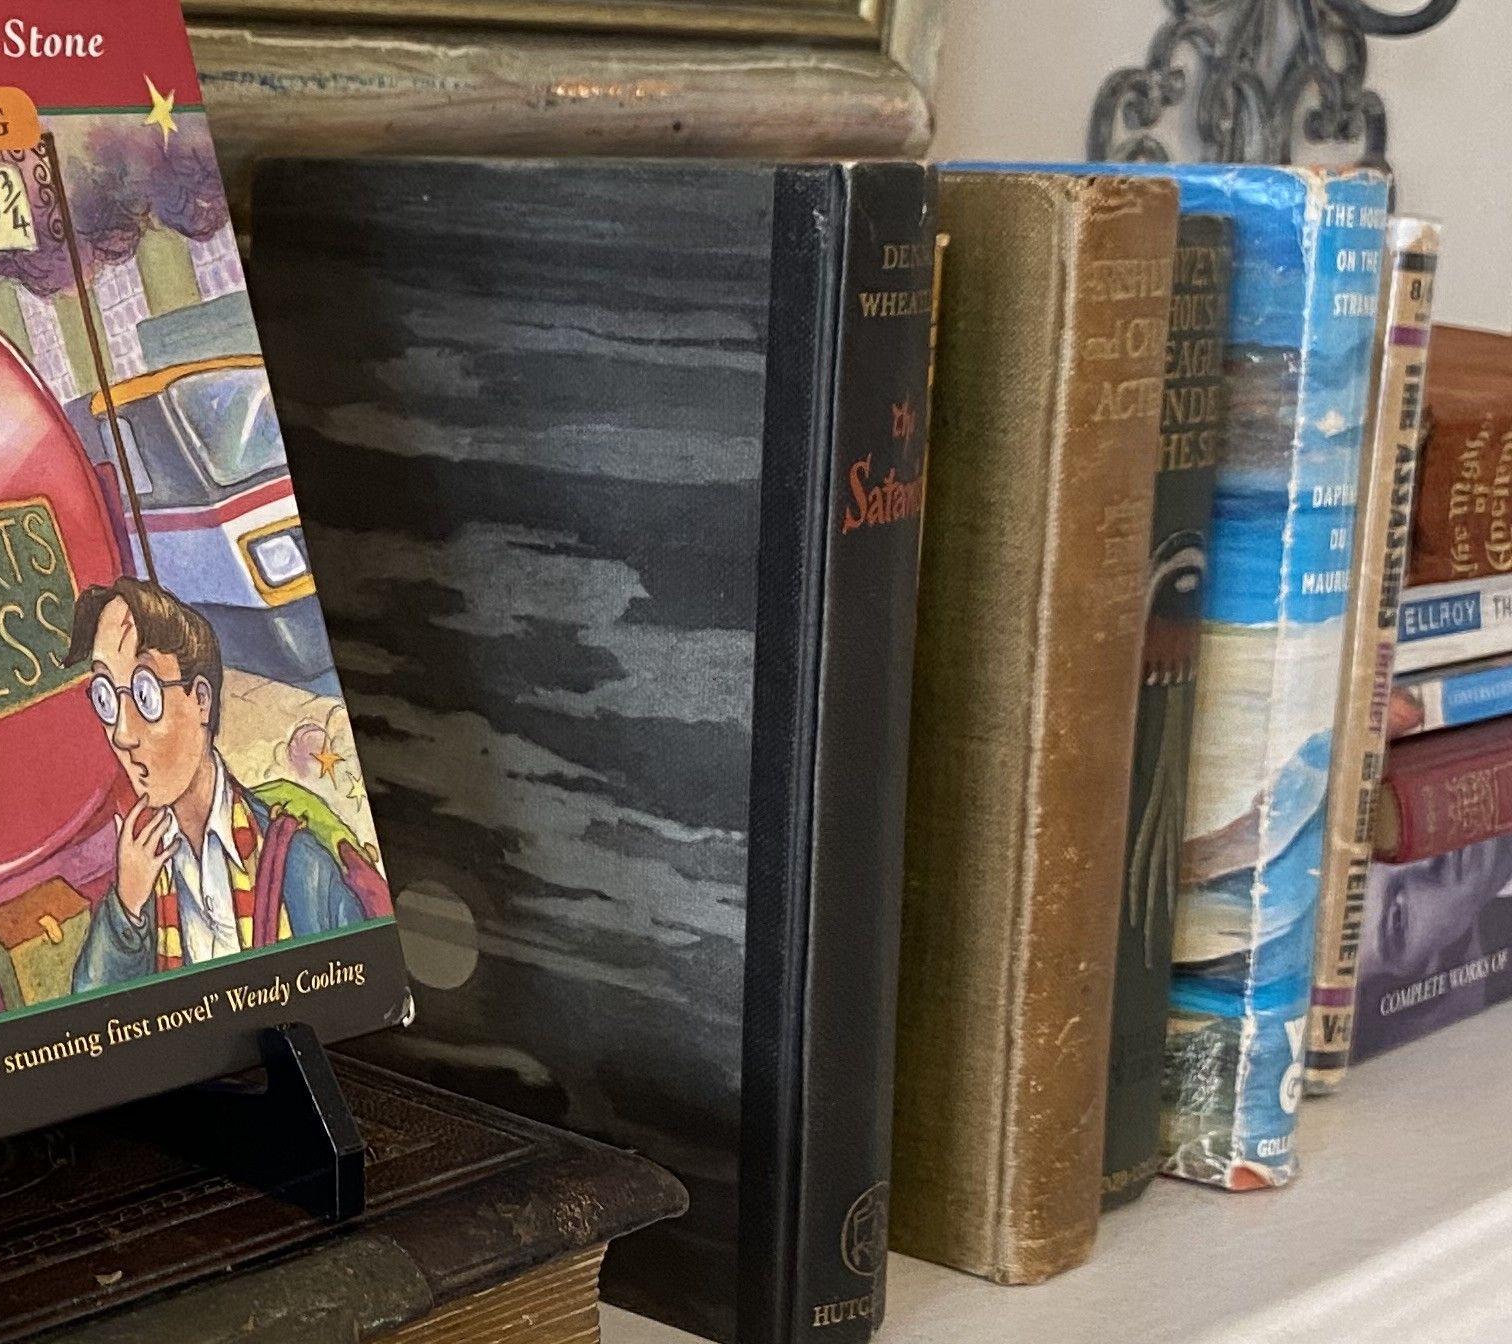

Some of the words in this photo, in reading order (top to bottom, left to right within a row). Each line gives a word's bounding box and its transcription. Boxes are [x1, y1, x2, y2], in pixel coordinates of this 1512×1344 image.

[3, 21, 105, 59] Stone
[1325, 203, 1355, 228] THE
[1336, 248, 1356, 272] ON
[1399, 363, 1423, 430] THE
[1378, 443, 1416, 629] ASSASSINS
[1404, 600, 1476, 634] ELLROY
[1379, 975, 1446, 1017] COMPLETE
[1449, 957, 1490, 989] WORKS
[1490, 950, 1508, 971] OF
[4, 1023, 103, 1074] stunning
[106, 1016, 152, 1051] first
[224, 972, 292, 1013] Wendy
[296, 960, 366, 992] Cooling
